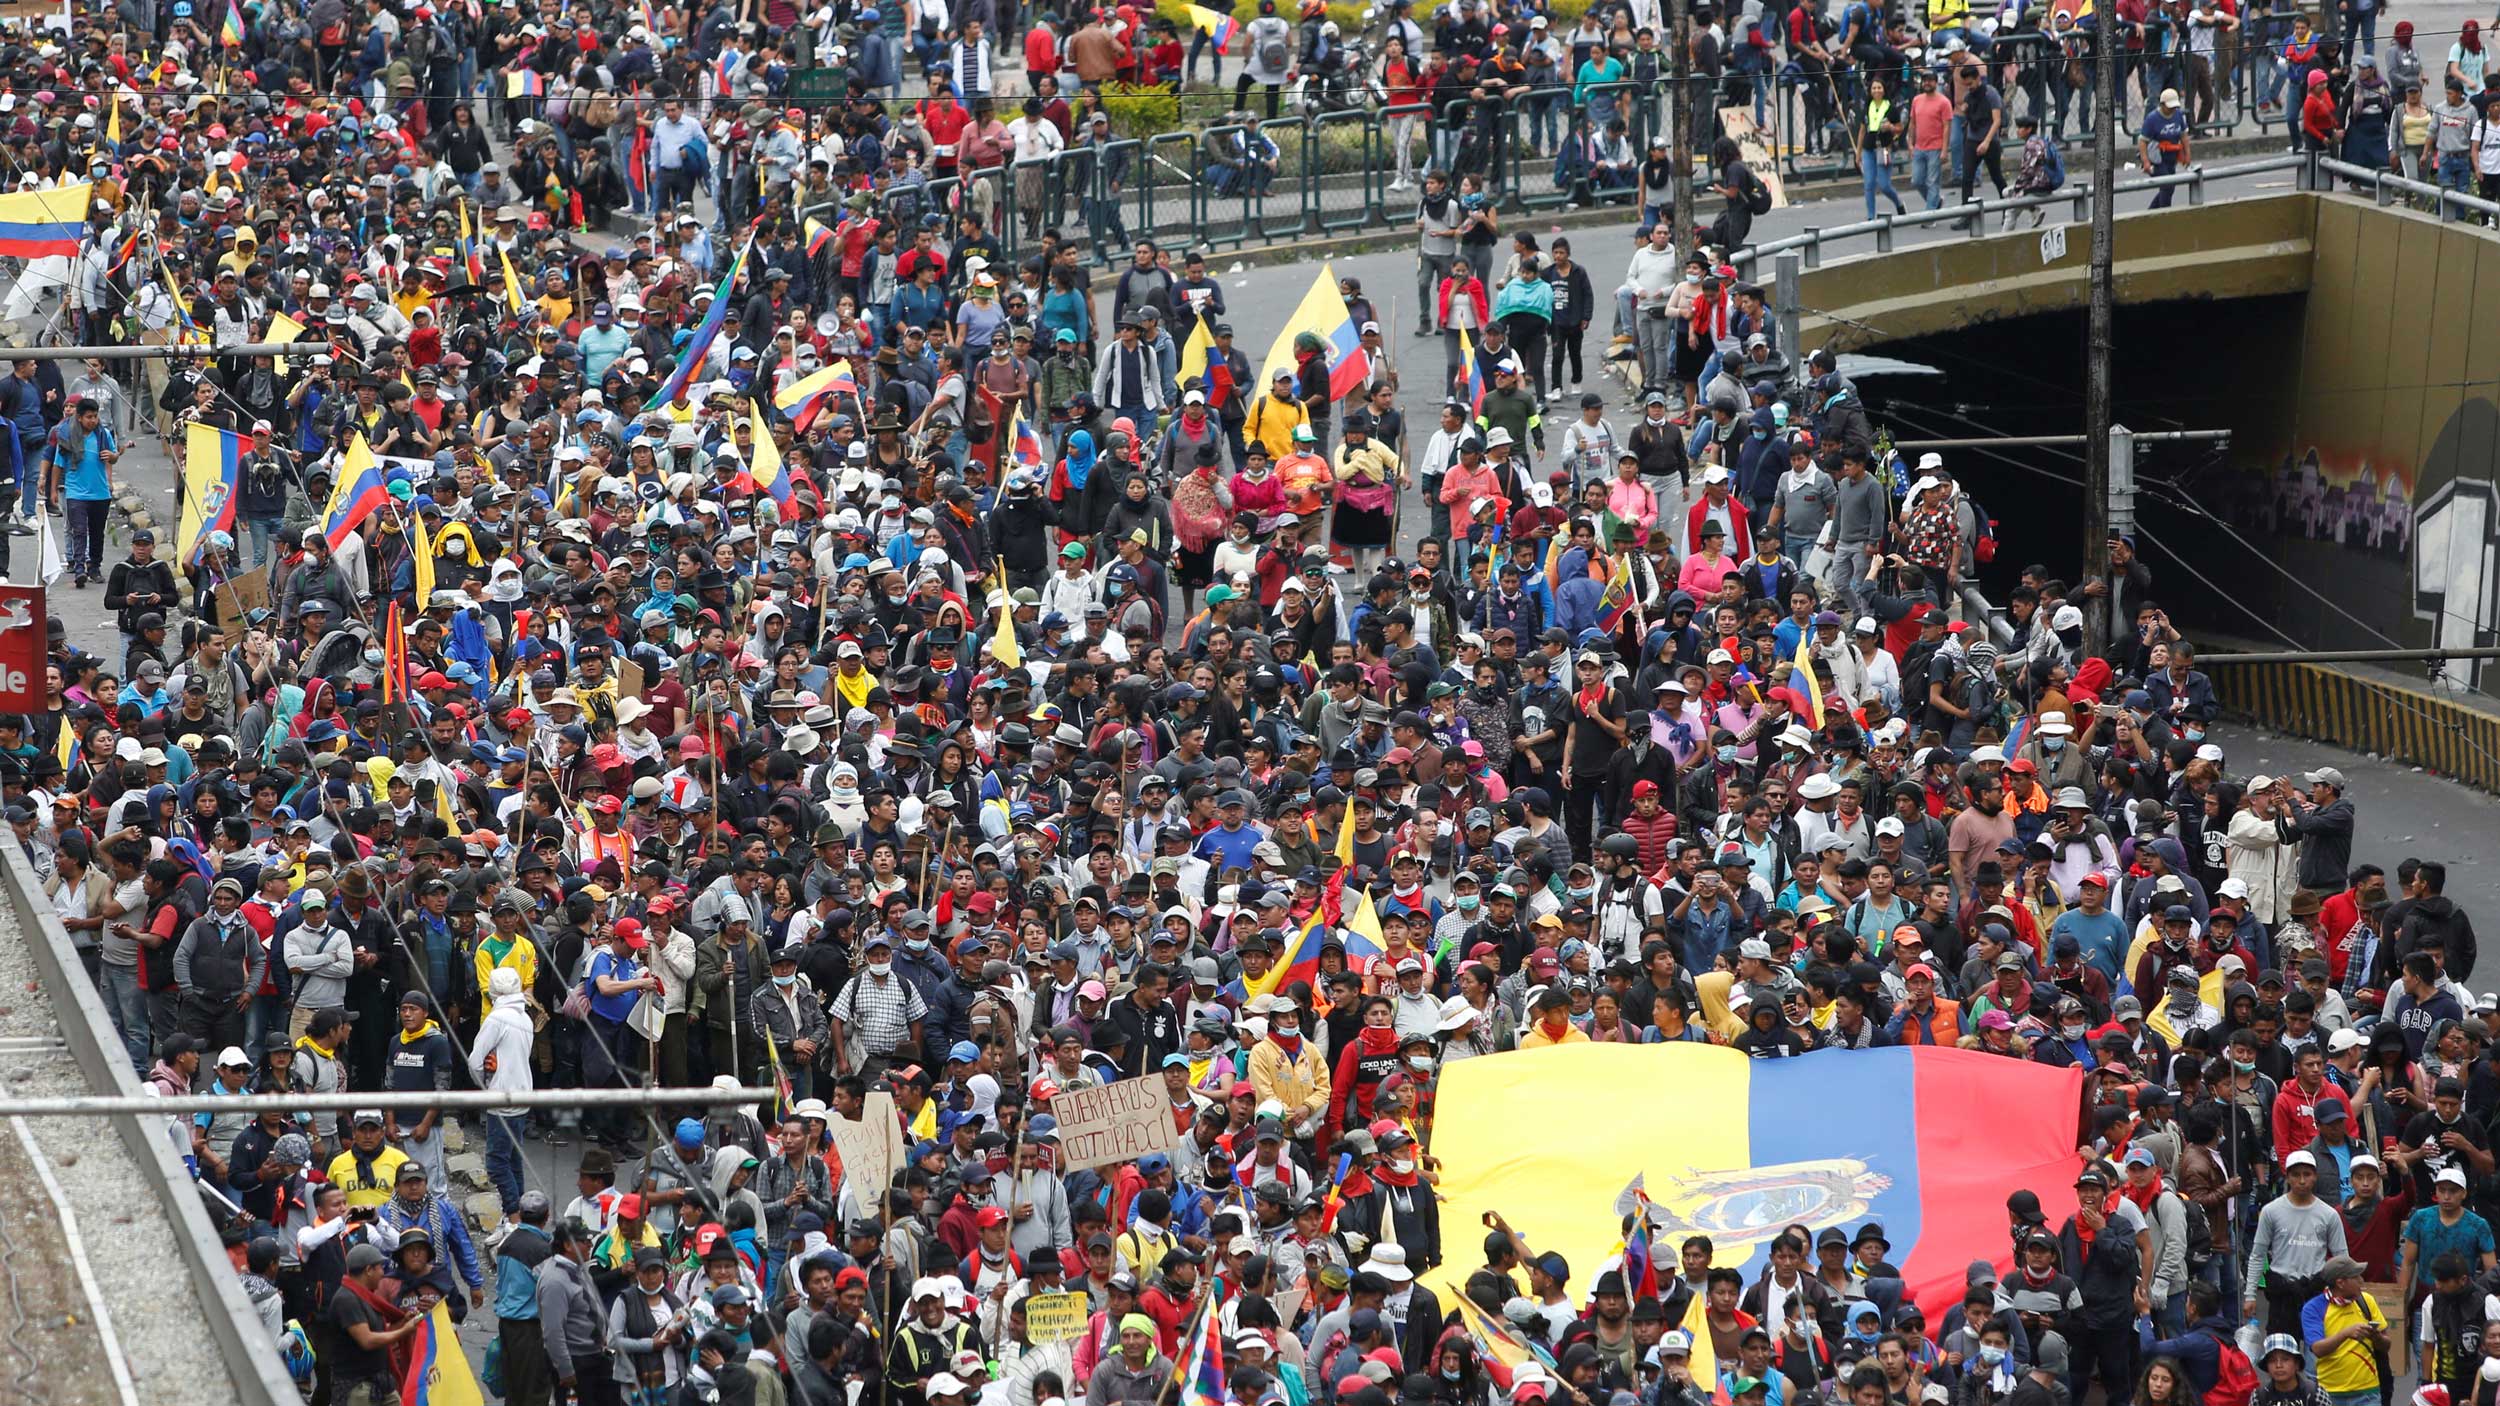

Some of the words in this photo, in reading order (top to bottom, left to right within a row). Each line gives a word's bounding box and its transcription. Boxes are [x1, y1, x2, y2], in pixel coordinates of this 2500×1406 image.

[2400, 1008, 2432, 1033] GAP
[1380, 1058, 1399, 1067] UNLT
[1054, 1077, 1157, 1127] GUERREROS
